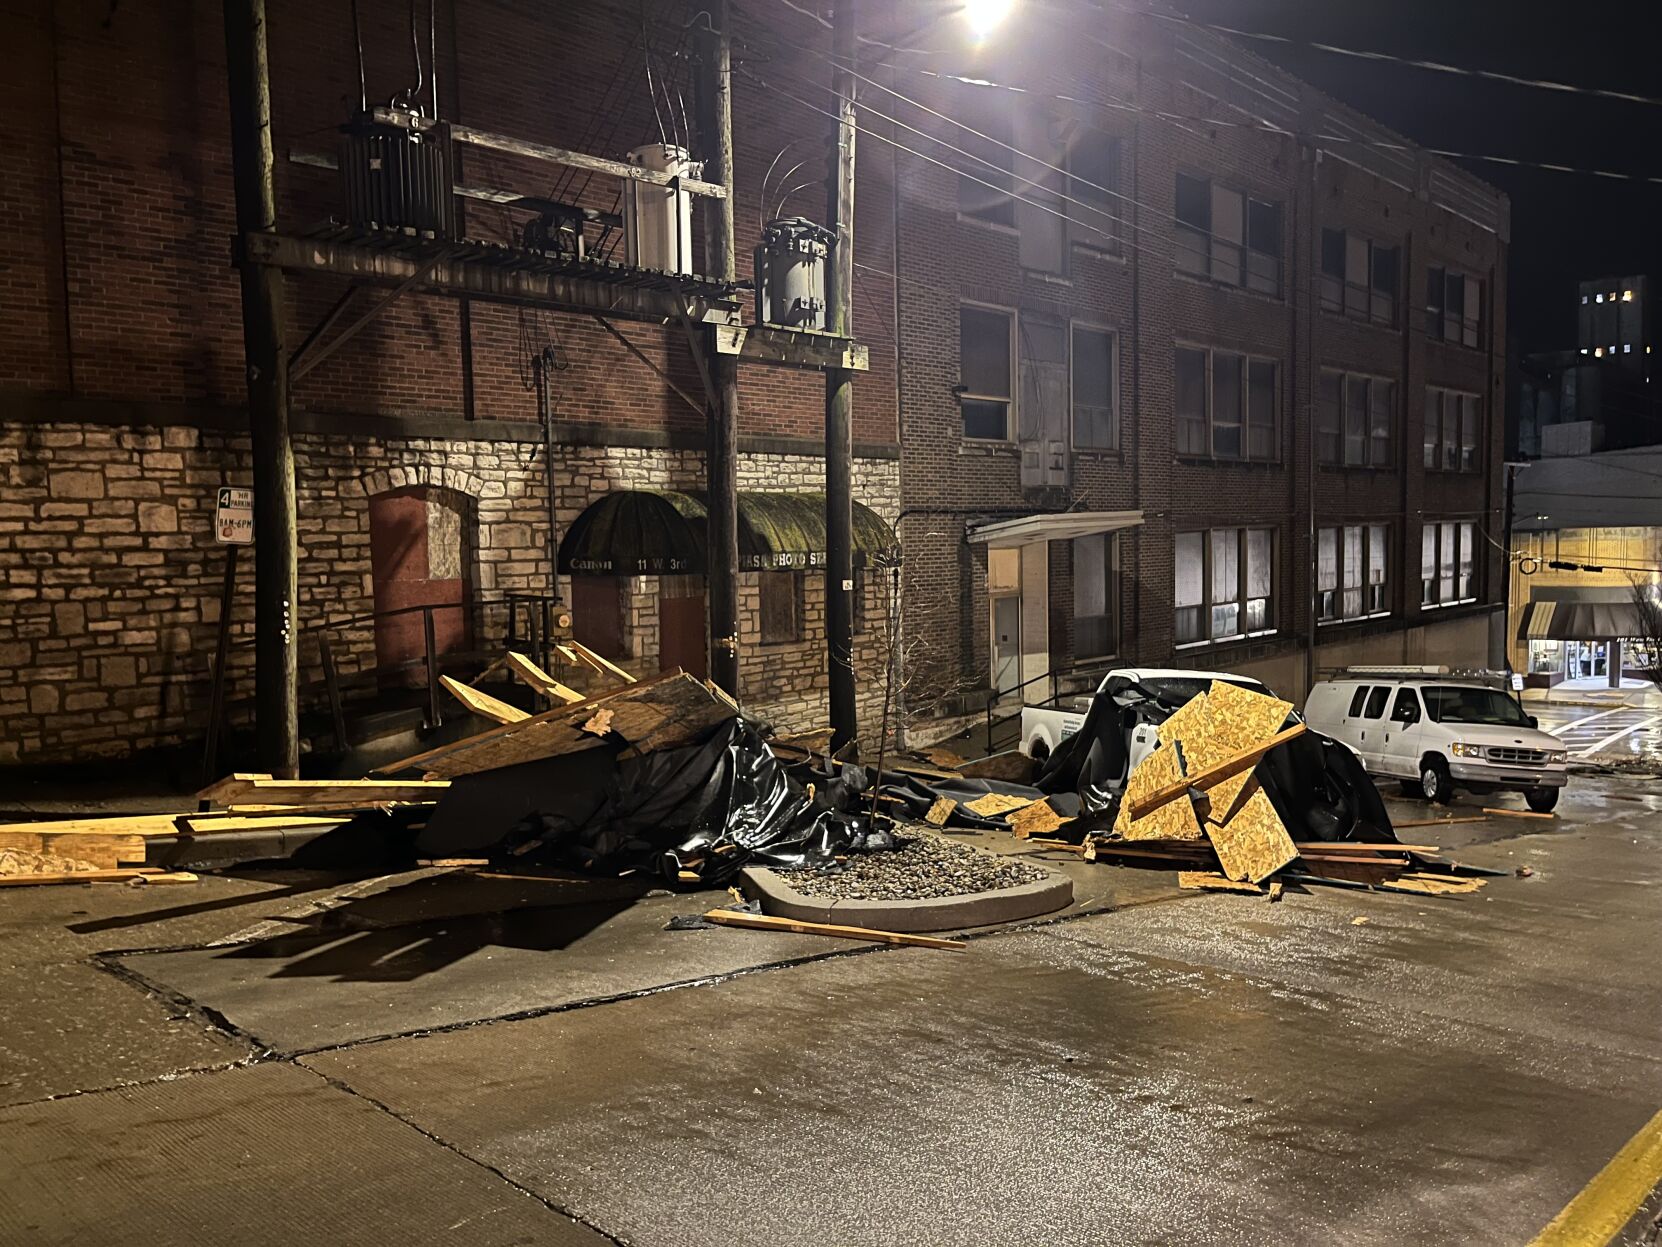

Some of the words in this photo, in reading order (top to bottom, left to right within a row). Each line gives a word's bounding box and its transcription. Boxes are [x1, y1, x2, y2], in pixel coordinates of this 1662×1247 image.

[220, 492, 230, 506] 4
[570, 558, 612, 570] Canon
[637, 559, 647, 571] 11
[670, 558, 688, 571] 3rd
[772, 552, 806, 567] PHOTO
